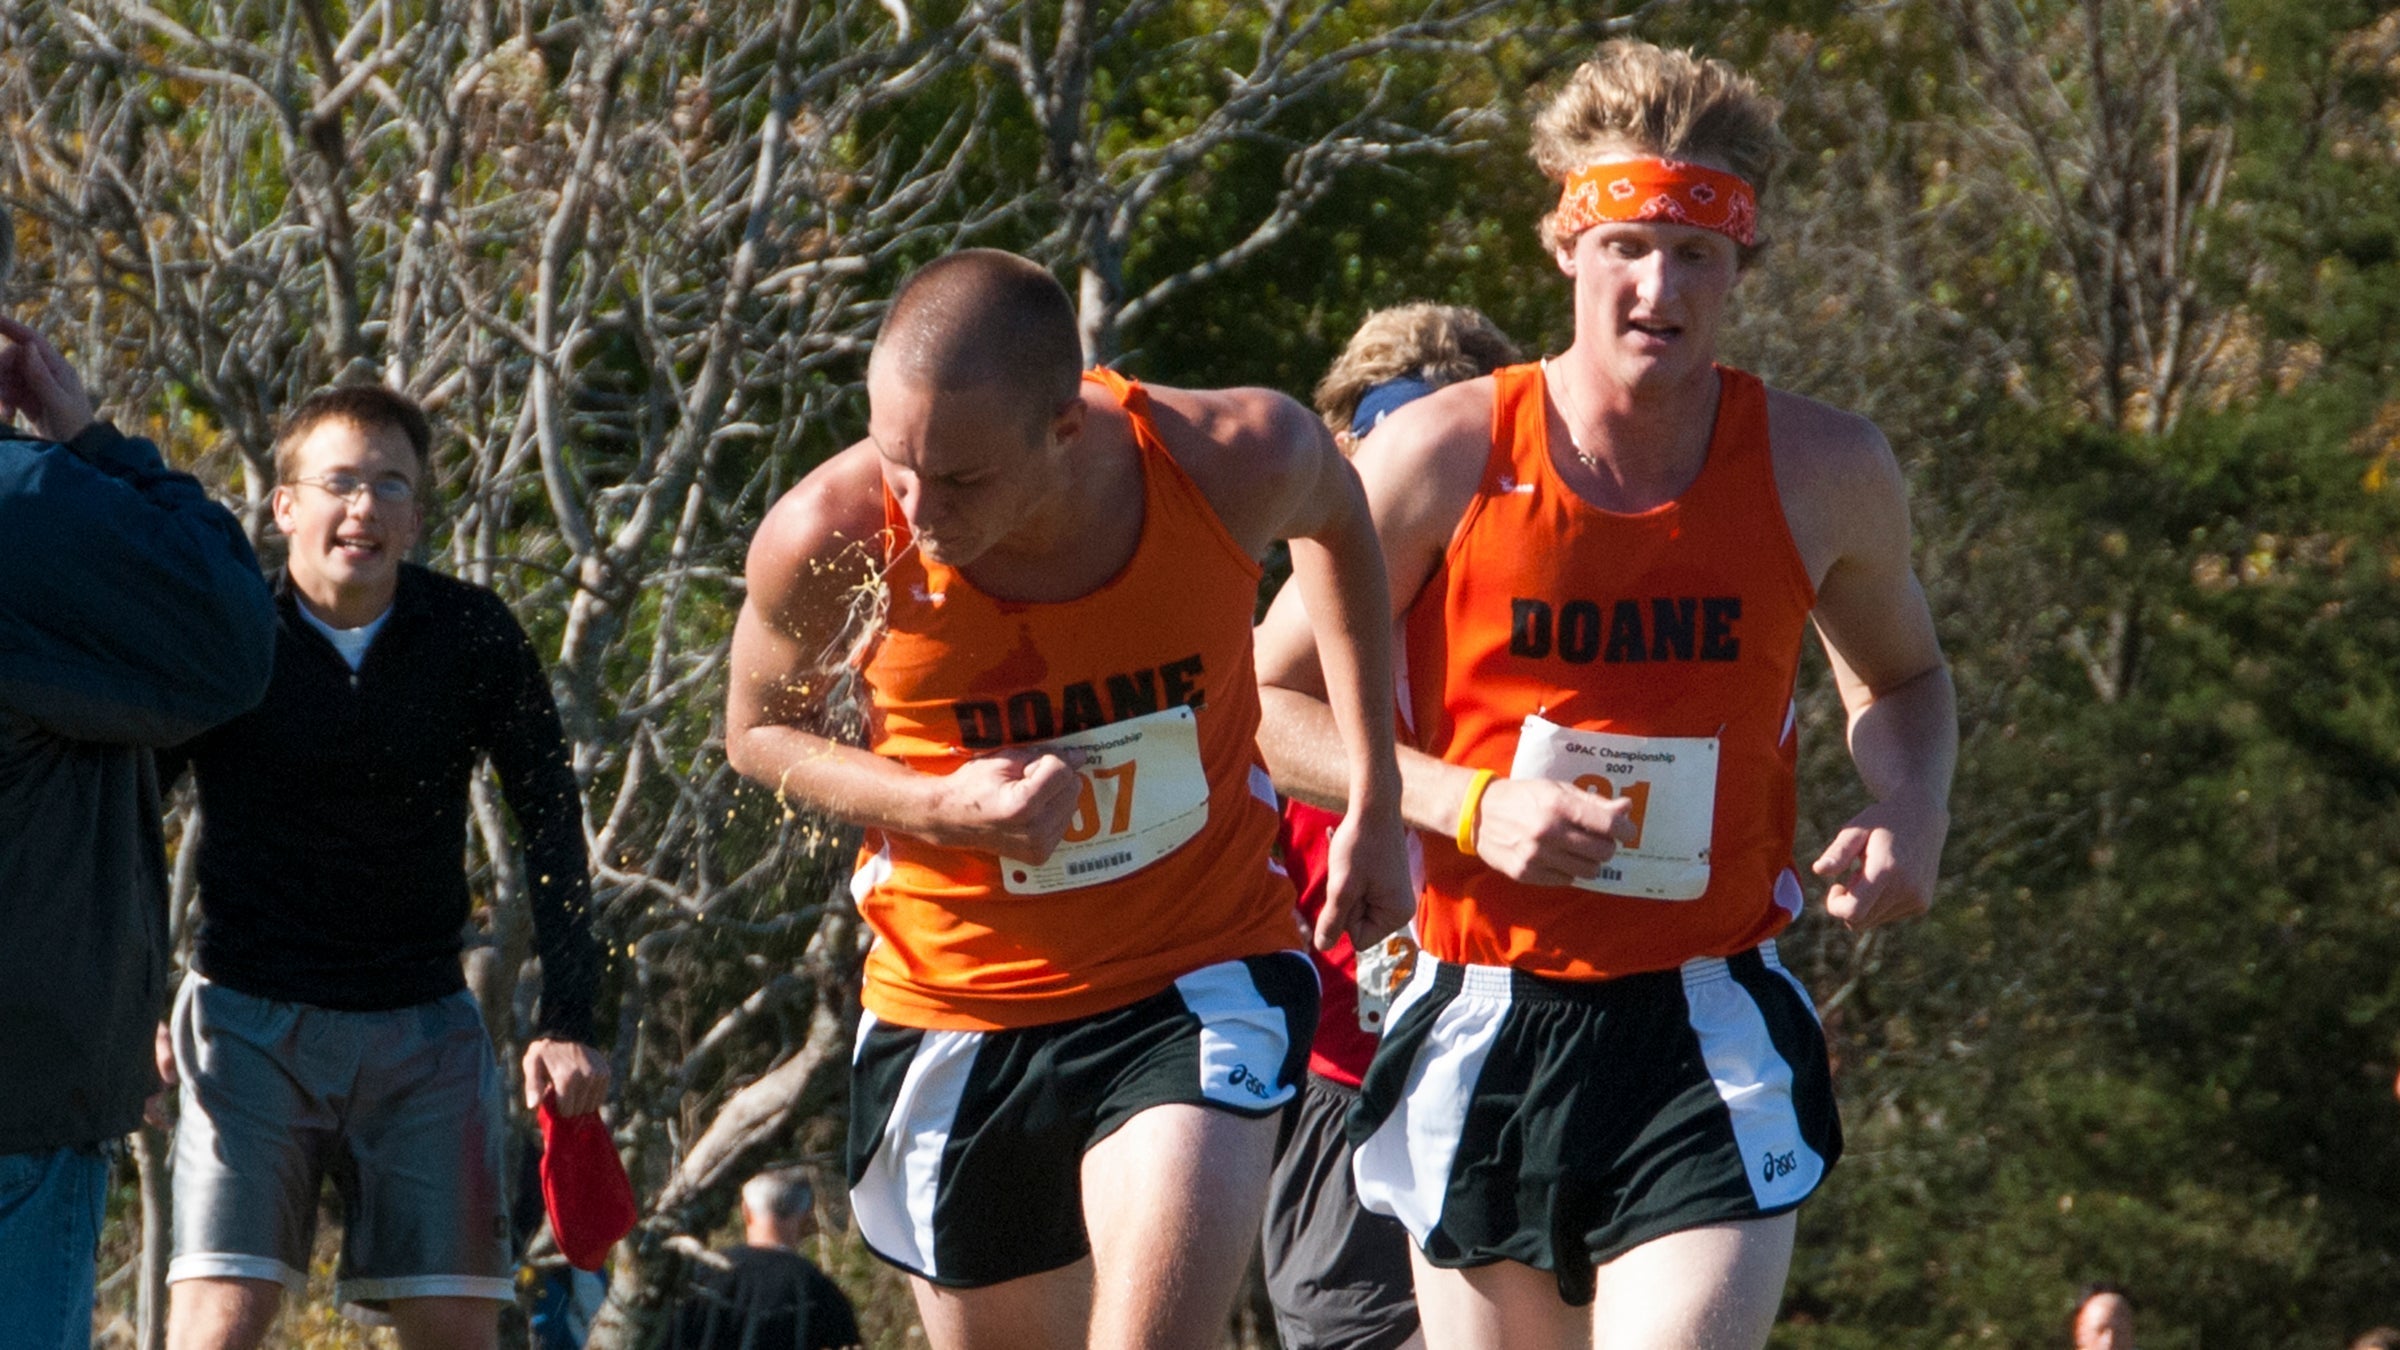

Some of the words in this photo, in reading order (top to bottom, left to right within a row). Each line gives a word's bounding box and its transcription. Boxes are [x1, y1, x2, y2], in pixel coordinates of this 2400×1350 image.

[1509, 597, 1741, 664] DOANE
[953, 653, 1205, 748] DOANE
[1063, 732, 1143, 753] ampionship
[1565, 743, 1597, 756] GPAC
[1600, 747, 1676, 764] Championship
[1605, 762, 1635, 775] 2007
